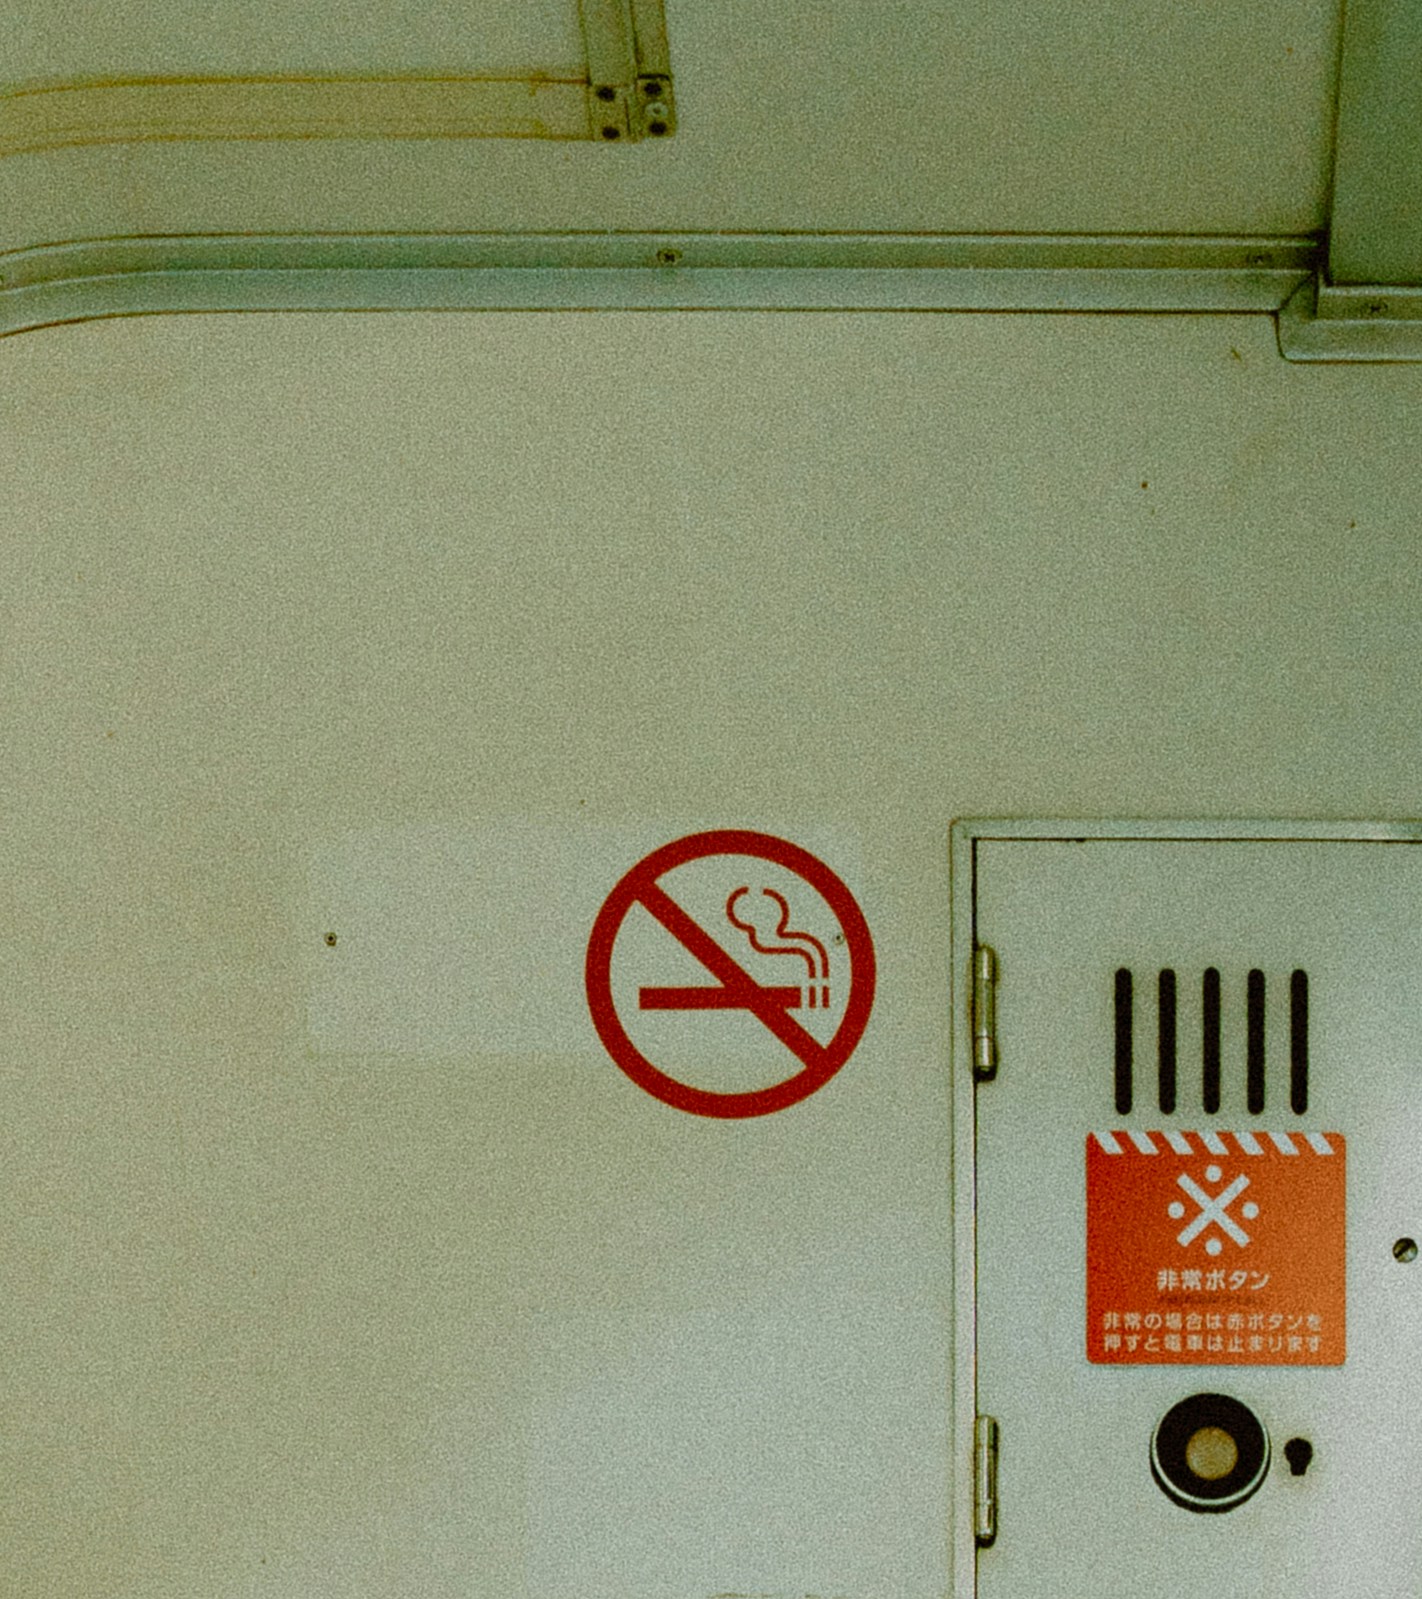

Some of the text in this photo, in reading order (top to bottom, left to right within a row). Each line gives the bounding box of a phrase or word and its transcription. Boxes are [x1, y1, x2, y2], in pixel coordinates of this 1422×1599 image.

[1156, 1269, 1270, 1291] 非常ボタン
[1103, 1312, 1321, 1330] 非常の場合は赤ボタンを
[1103, 1334, 1321, 1352] 押すと電車は止まります
